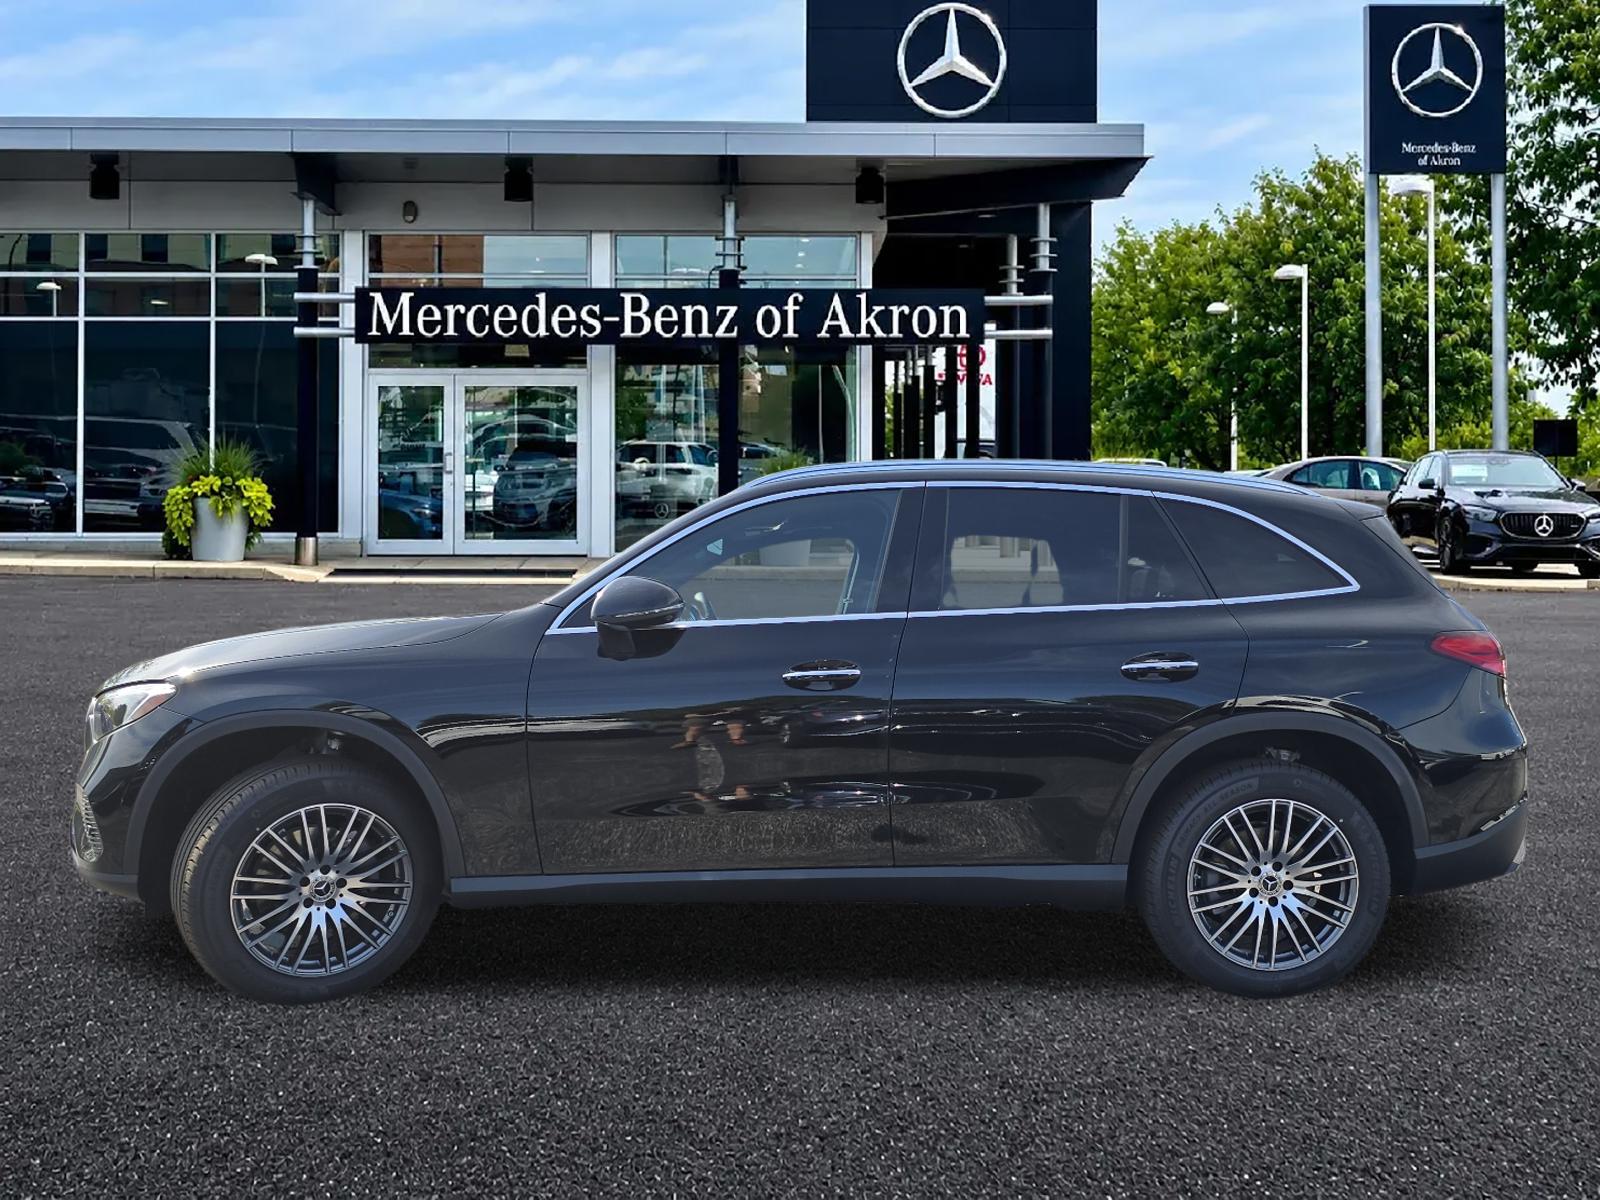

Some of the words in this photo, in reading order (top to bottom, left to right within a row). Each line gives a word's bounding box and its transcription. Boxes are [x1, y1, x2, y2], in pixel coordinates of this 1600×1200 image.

[1401, 141, 1477, 154] Mercedes-Benz
[1417, 154, 1428, 166] of
[1429, 154, 1461, 166] Akron
[367, 291, 738, 338] Mercedes-Benz
[755, 291, 804, 339] of
[816, 291, 971, 339] Akron
